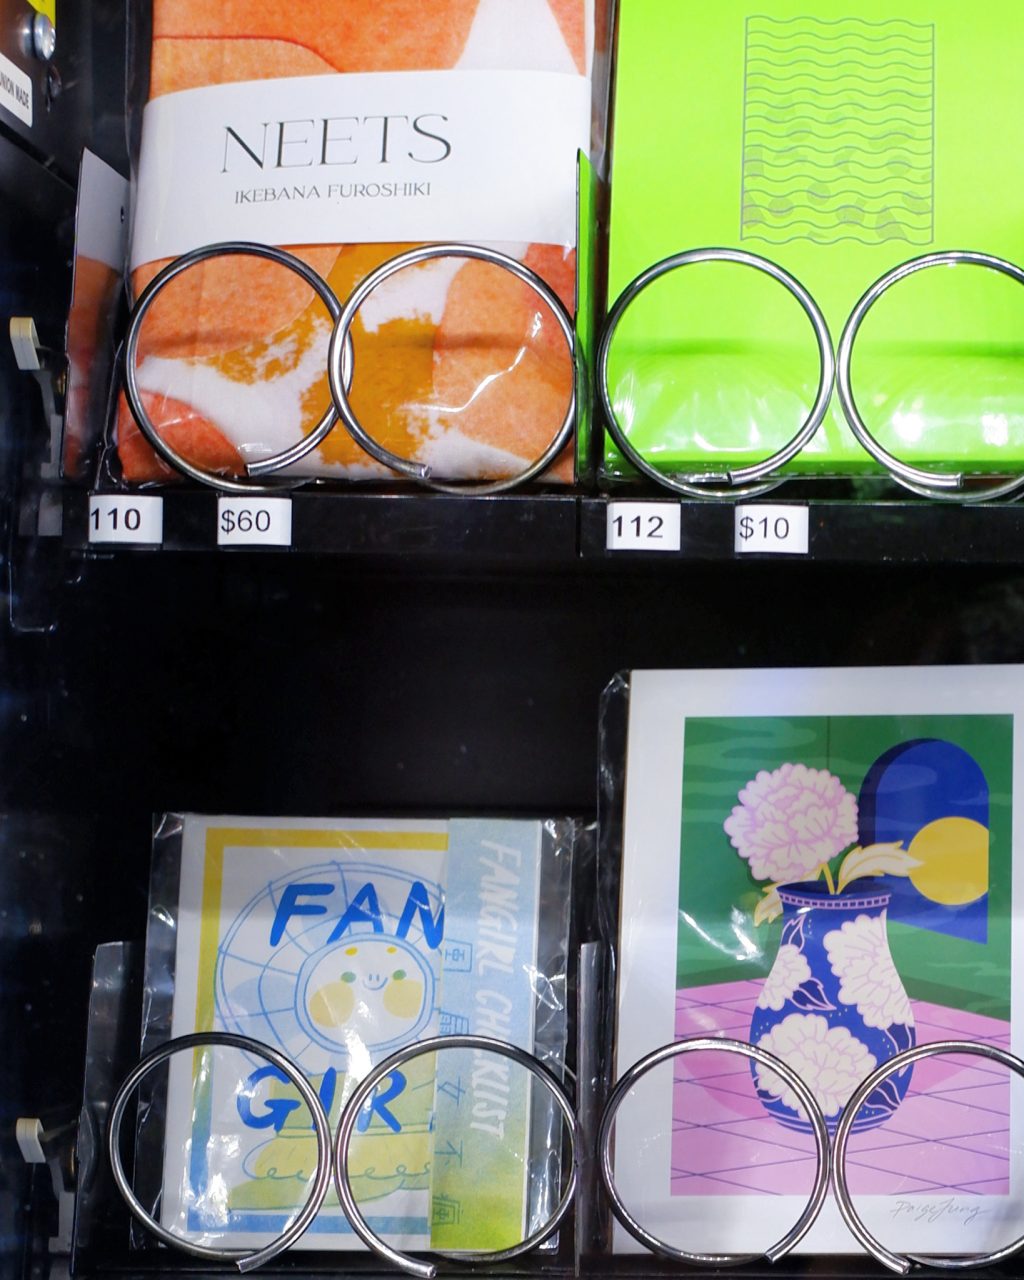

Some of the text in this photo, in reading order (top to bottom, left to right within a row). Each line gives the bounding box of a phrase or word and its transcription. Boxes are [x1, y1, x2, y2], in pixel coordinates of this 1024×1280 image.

[220, 113, 452, 174] NEETS
[234, 182, 432, 204] IKEBANA FUROSHIKI
[90, 508, 140, 530] 110
[221, 510, 270, 534] $60
[613, 516, 663, 537] 112
[741, 517, 789, 540] $10
[270, 881, 446, 949] FAN
[470, 839, 522, 1142] FANGIRL CHKLIST
